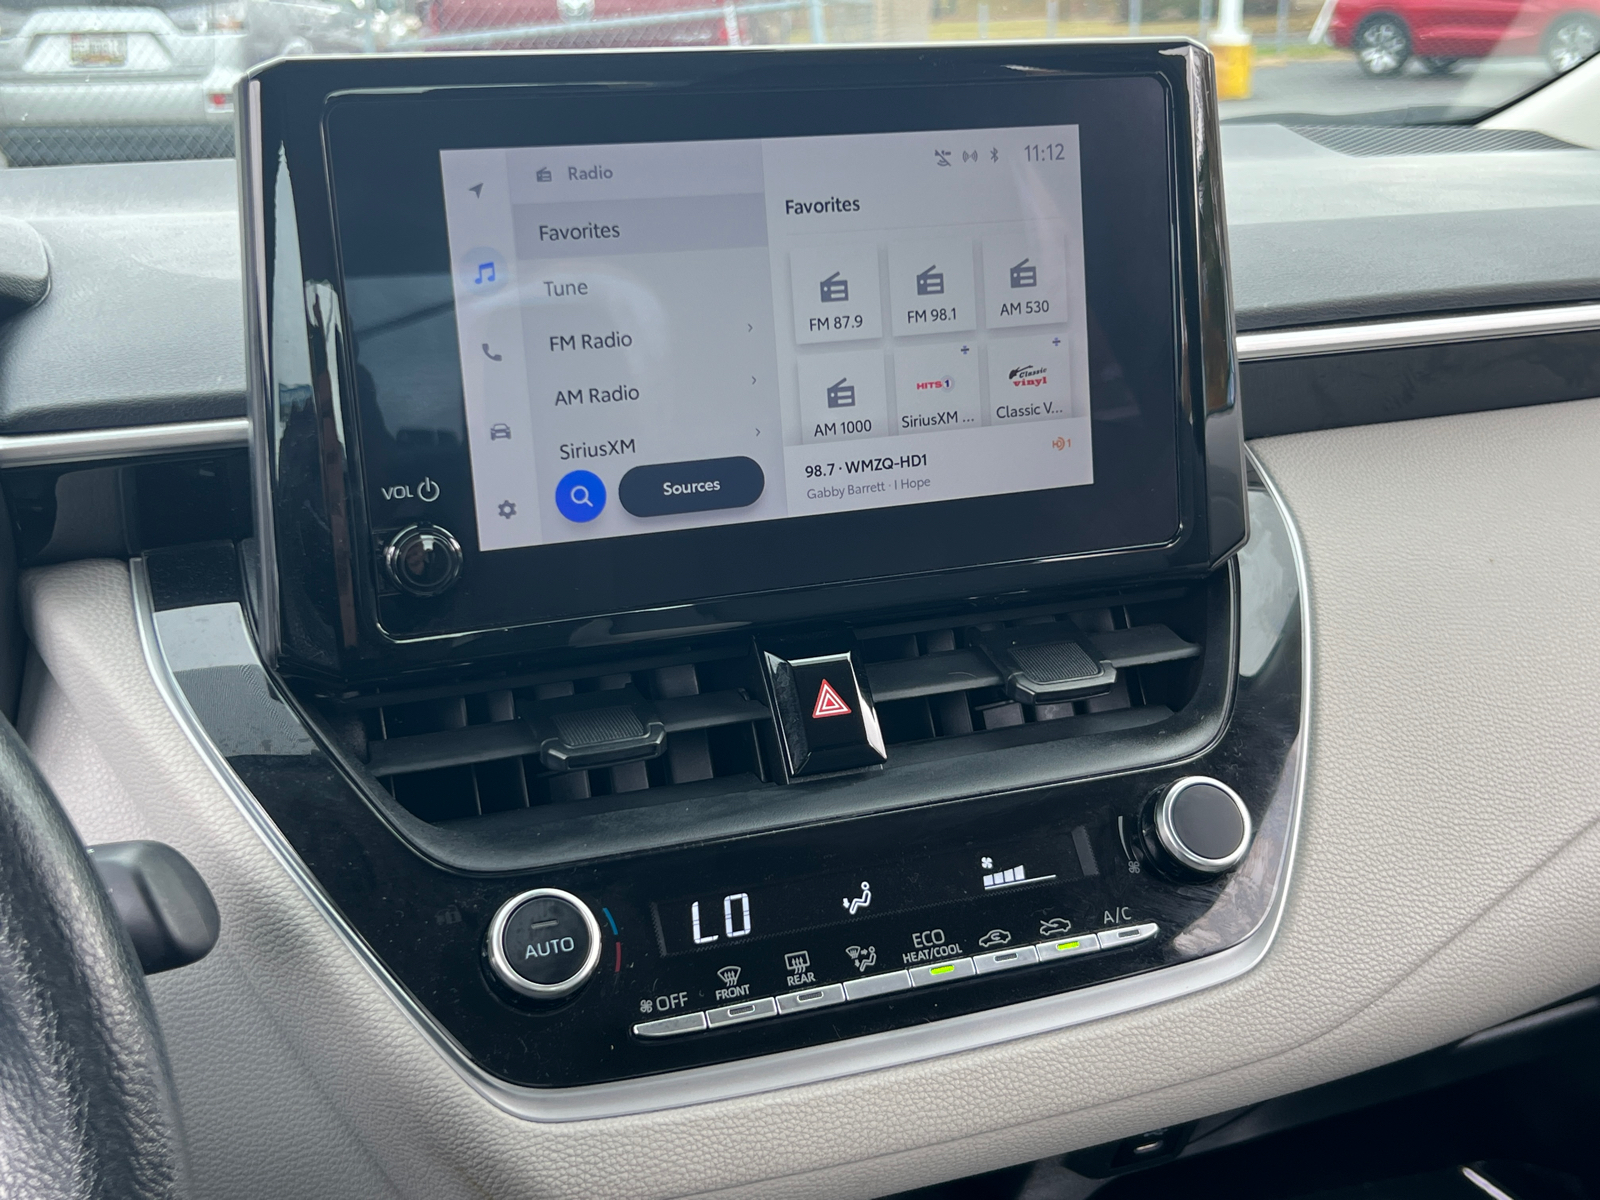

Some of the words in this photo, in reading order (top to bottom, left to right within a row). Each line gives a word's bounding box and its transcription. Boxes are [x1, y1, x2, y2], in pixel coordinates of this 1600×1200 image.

[1024, 143, 1065, 162] 11:12
[567, 165, 613, 181] Radio
[785, 197, 860, 215] Favorites
[539, 222, 620, 241] Favorites
[543, 280, 589, 298] Tune
[907, 309, 927, 323] FM
[930, 308, 957, 322] 98.1
[1000, 302, 1022, 317] AM
[1025, 300, 1050, 315] 530
[809, 317, 830, 331] FM
[833, 315, 863, 330] 87.9
[550, 334, 576, 351] FM
[582, 332, 633, 350] Radio
[1013, 376, 1047, 387] vinyl
[1018, 366, 1048, 379] Classic
[555, 389, 583, 406] AM
[589, 385, 640, 403] Radio
[901, 411, 958, 429] SiriusXM
[996, 403, 1041, 420] Classic
[814, 422, 837, 437] AM
[841, 419, 872, 435] 1000
[559, 439, 636, 460] SiriusXM
[805, 463, 835, 478] 98.7
[845, 454, 928, 475] WMZQ-HD1
[381, 485, 414, 500] VOL
[663, 478, 721, 496] Sources
[806, 485, 845, 501] Gabby
[847, 482, 886, 496] Barrett
[900, 477, 931, 492] Hope
[691, 893, 751, 944] LO
[1103, 906, 1132, 924] A/C
[912, 929, 945, 947] ECO
[525, 937, 575, 960] AUTO
[902, 944, 963, 964] HEAT/COOL
[787, 972, 816, 986] REAR
[715, 984, 751, 1000] FRONT
[656, 992, 688, 1011] OFF
